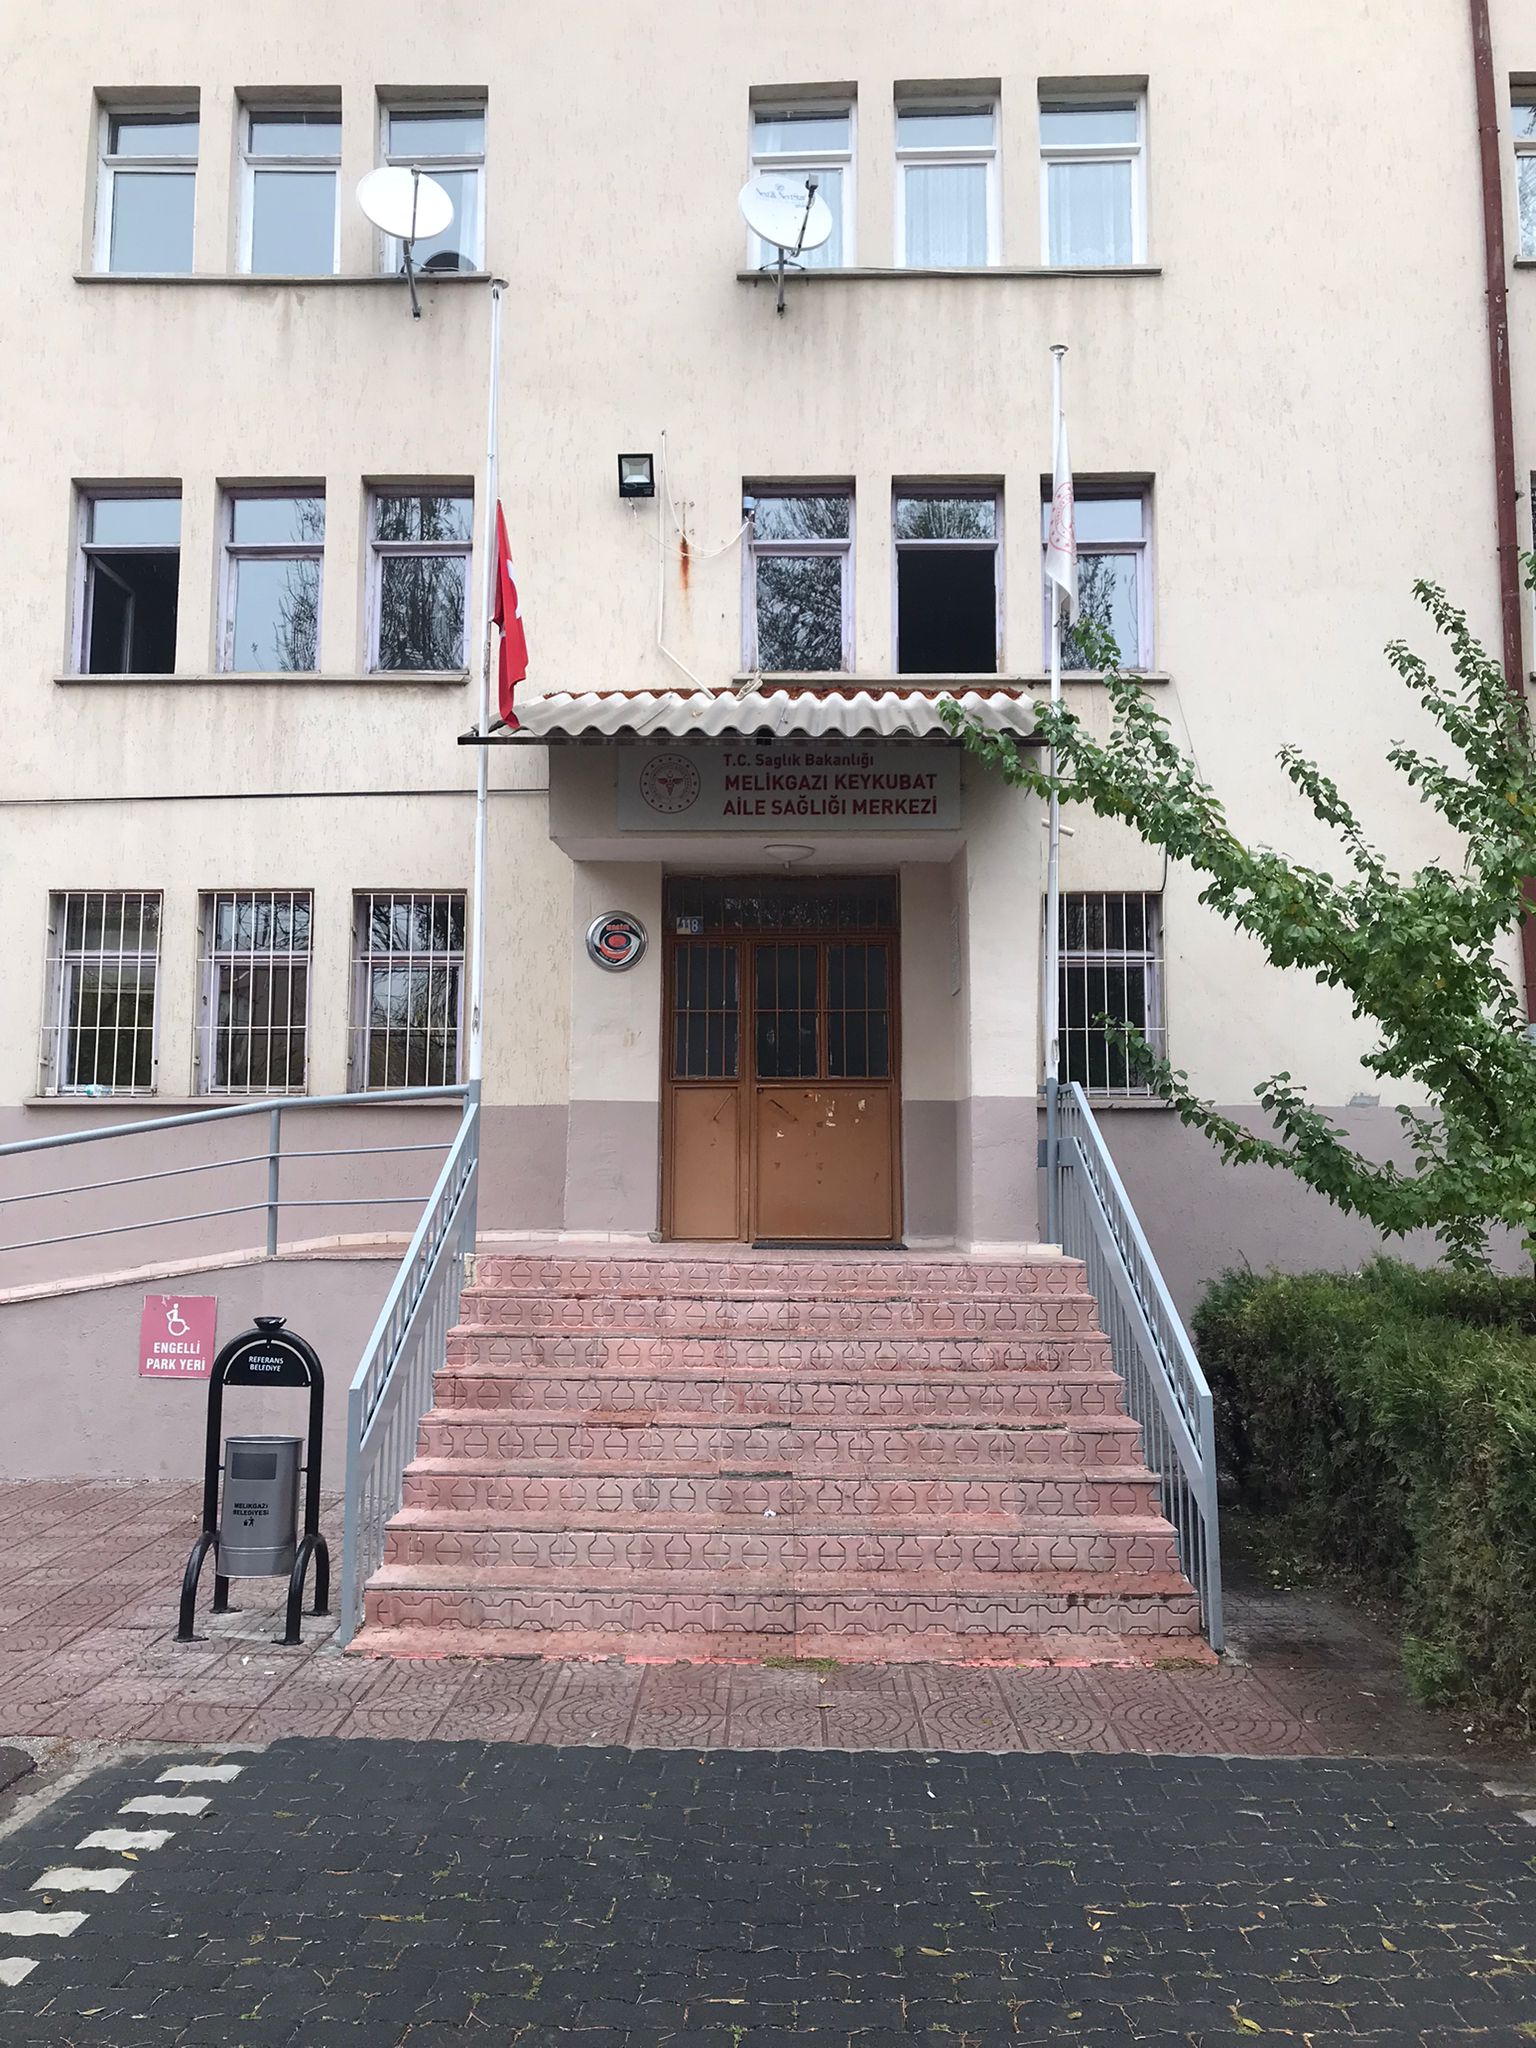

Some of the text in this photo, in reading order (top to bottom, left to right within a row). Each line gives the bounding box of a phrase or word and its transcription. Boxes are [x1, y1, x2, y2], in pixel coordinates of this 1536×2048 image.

[723, 753, 751, 767] T.C.
[805, 752, 874, 769] Bakanlığı
[834, 773, 938, 790] KEYKUBAT
[723, 795, 937, 816] AİLE SAĞLIĞI MERKEZİ
[153, 1340, 201, 1354] ENGELLİ
[146, 1357, 206, 1371] PARK YERİ
[248, 1355, 284, 1365] REFERANS
